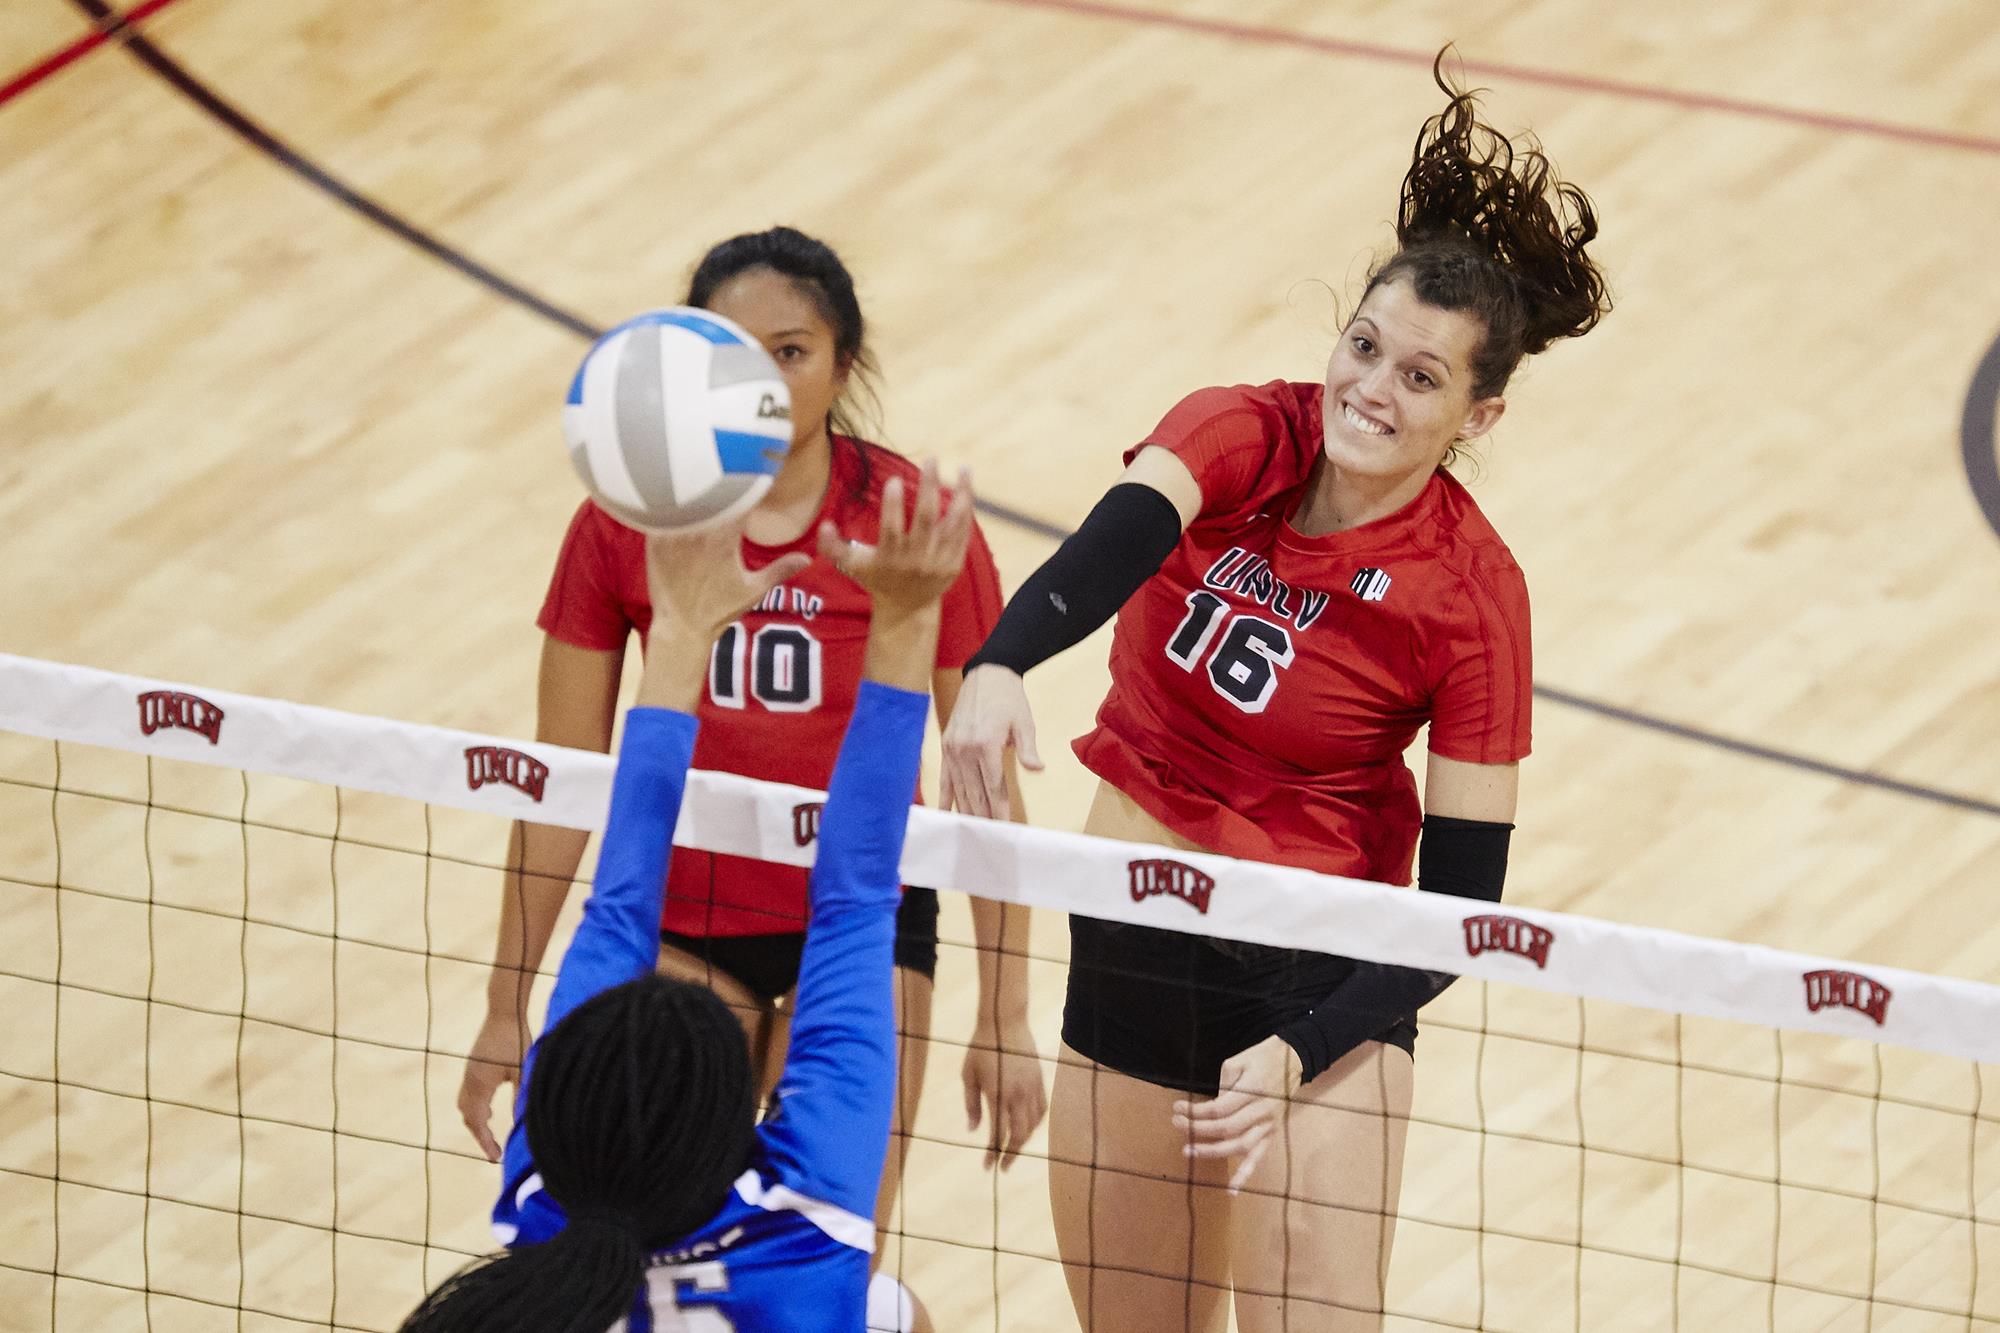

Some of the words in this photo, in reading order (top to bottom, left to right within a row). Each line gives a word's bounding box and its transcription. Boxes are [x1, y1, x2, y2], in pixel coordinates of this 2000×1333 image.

[1203, 546, 1330, 631] UNLV
[708, 620, 822, 713] 10
[1165, 589, 1295, 714] 16
[137, 690, 225, 746] UNLV
[464, 746, 550, 803] UNLV
[1128, 858, 1216, 914] UNLV
[1462, 914, 1555, 970] UNLV
[1803, 969, 1892, 1027] UNLV
